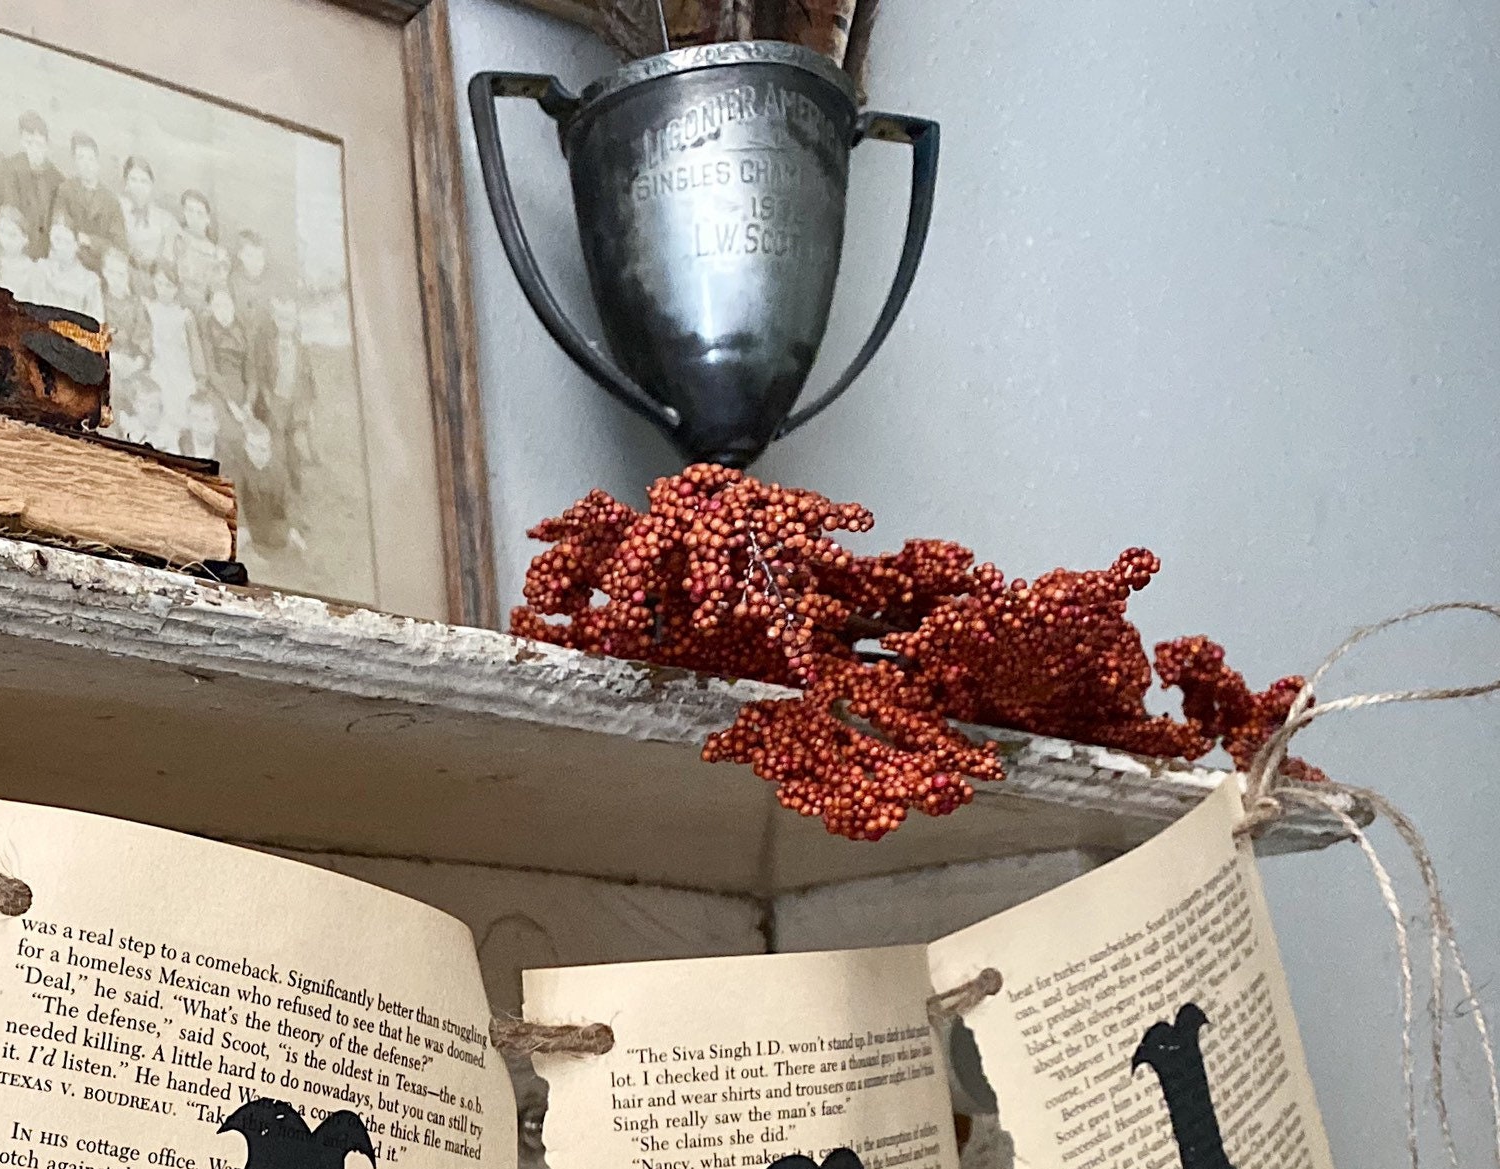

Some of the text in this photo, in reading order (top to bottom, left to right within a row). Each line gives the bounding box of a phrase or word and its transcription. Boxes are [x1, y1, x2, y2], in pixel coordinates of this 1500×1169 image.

[634, 161, 731, 201] SINGLES
[22, 919, 488, 1050] was a real step to a comeback. Significantly better than struggling
[94, 978, 116, 1000] he
[124, 990, 163, 1010] said.
[246, 1011, 270, 1032] the
[278, 1018, 324, 1048] theory
[330, 1032, 346, 1050] of
[348, 1036, 368, 1056] the
[61, 1082, 74, 1096] V.
[84, 1086, 176, 1116] BOUDREAU.
[614, 1114, 658, 1133] Singh
[666, 1110, 708, 1129] really
[715, 1113, 742, 1124] saw
[748, 1106, 771, 1122] the
[777, 1101, 817, 1120] man's
[676, 1133, 723, 1149] claims
[730, 1129, 754, 1145] she
